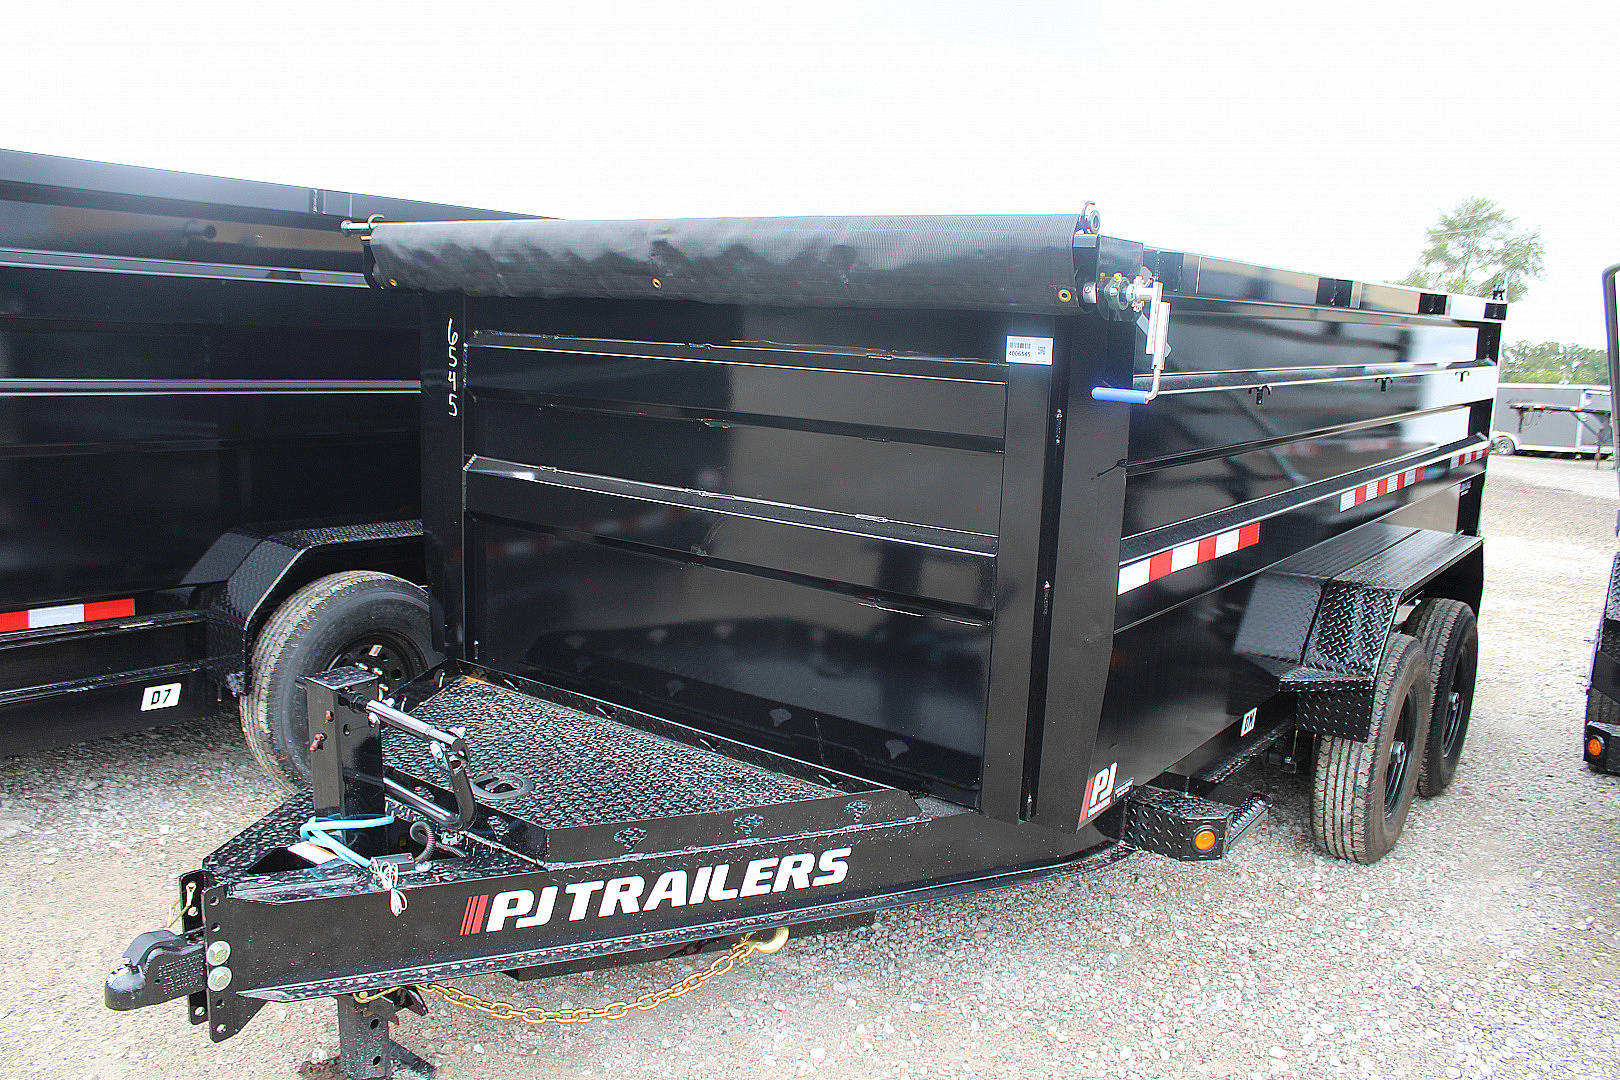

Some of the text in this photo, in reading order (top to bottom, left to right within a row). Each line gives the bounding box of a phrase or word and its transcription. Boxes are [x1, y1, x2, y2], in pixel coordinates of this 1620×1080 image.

[447, 317, 459, 417] 6545
[1008, 350, 1031, 358] 4006545
[151, 688, 172, 705] D7
[1088, 761, 1118, 808] PJ
[485, 847, 853, 933] PJ TRAILERS
